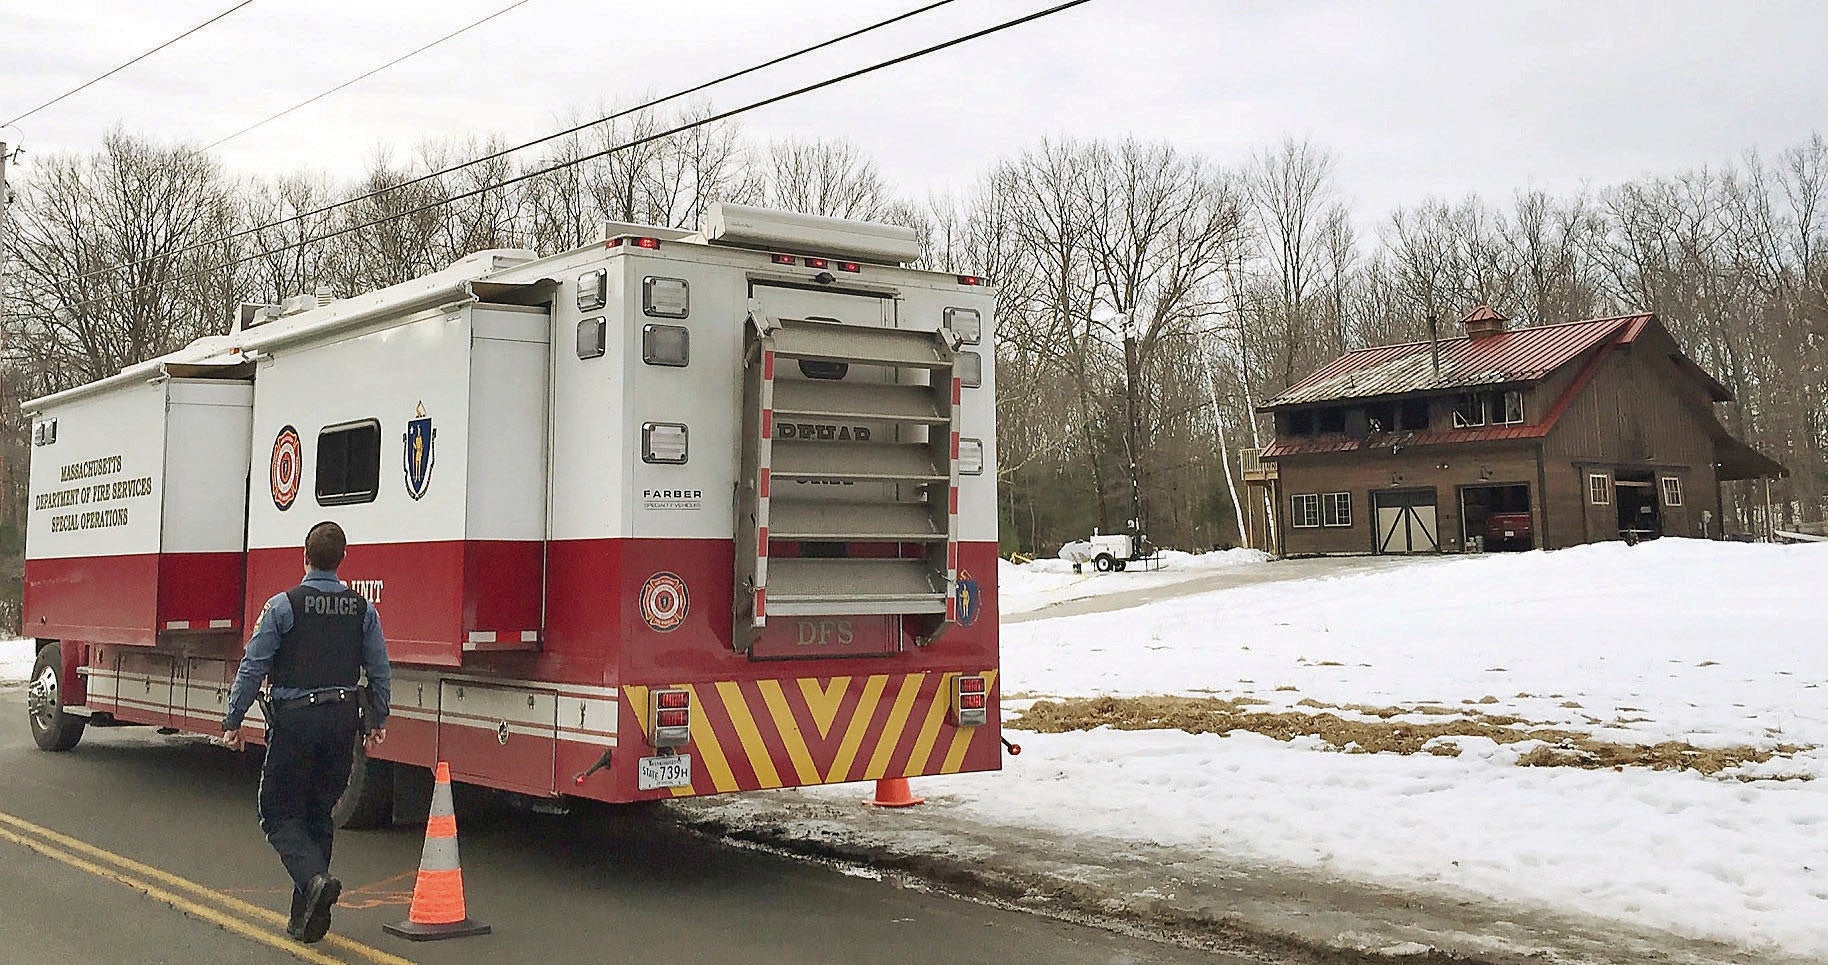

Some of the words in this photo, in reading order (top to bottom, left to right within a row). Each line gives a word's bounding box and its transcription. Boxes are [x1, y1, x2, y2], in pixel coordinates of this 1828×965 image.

[60, 455, 122, 482] MASSACHUSETTS
[35, 488, 80, 510] DEPARTMENT
[81, 485, 91, 504] OF
[92, 483, 110, 502] FIRE
[112, 477, 152, 500] SERVICES
[643, 490, 701, 498] FARBER
[51, 513, 79, 533] SPECIAL
[80, 508, 128, 529] OPERATIONS
[304, 595, 358, 615] POLICE
[797, 620, 854, 645] DFS
